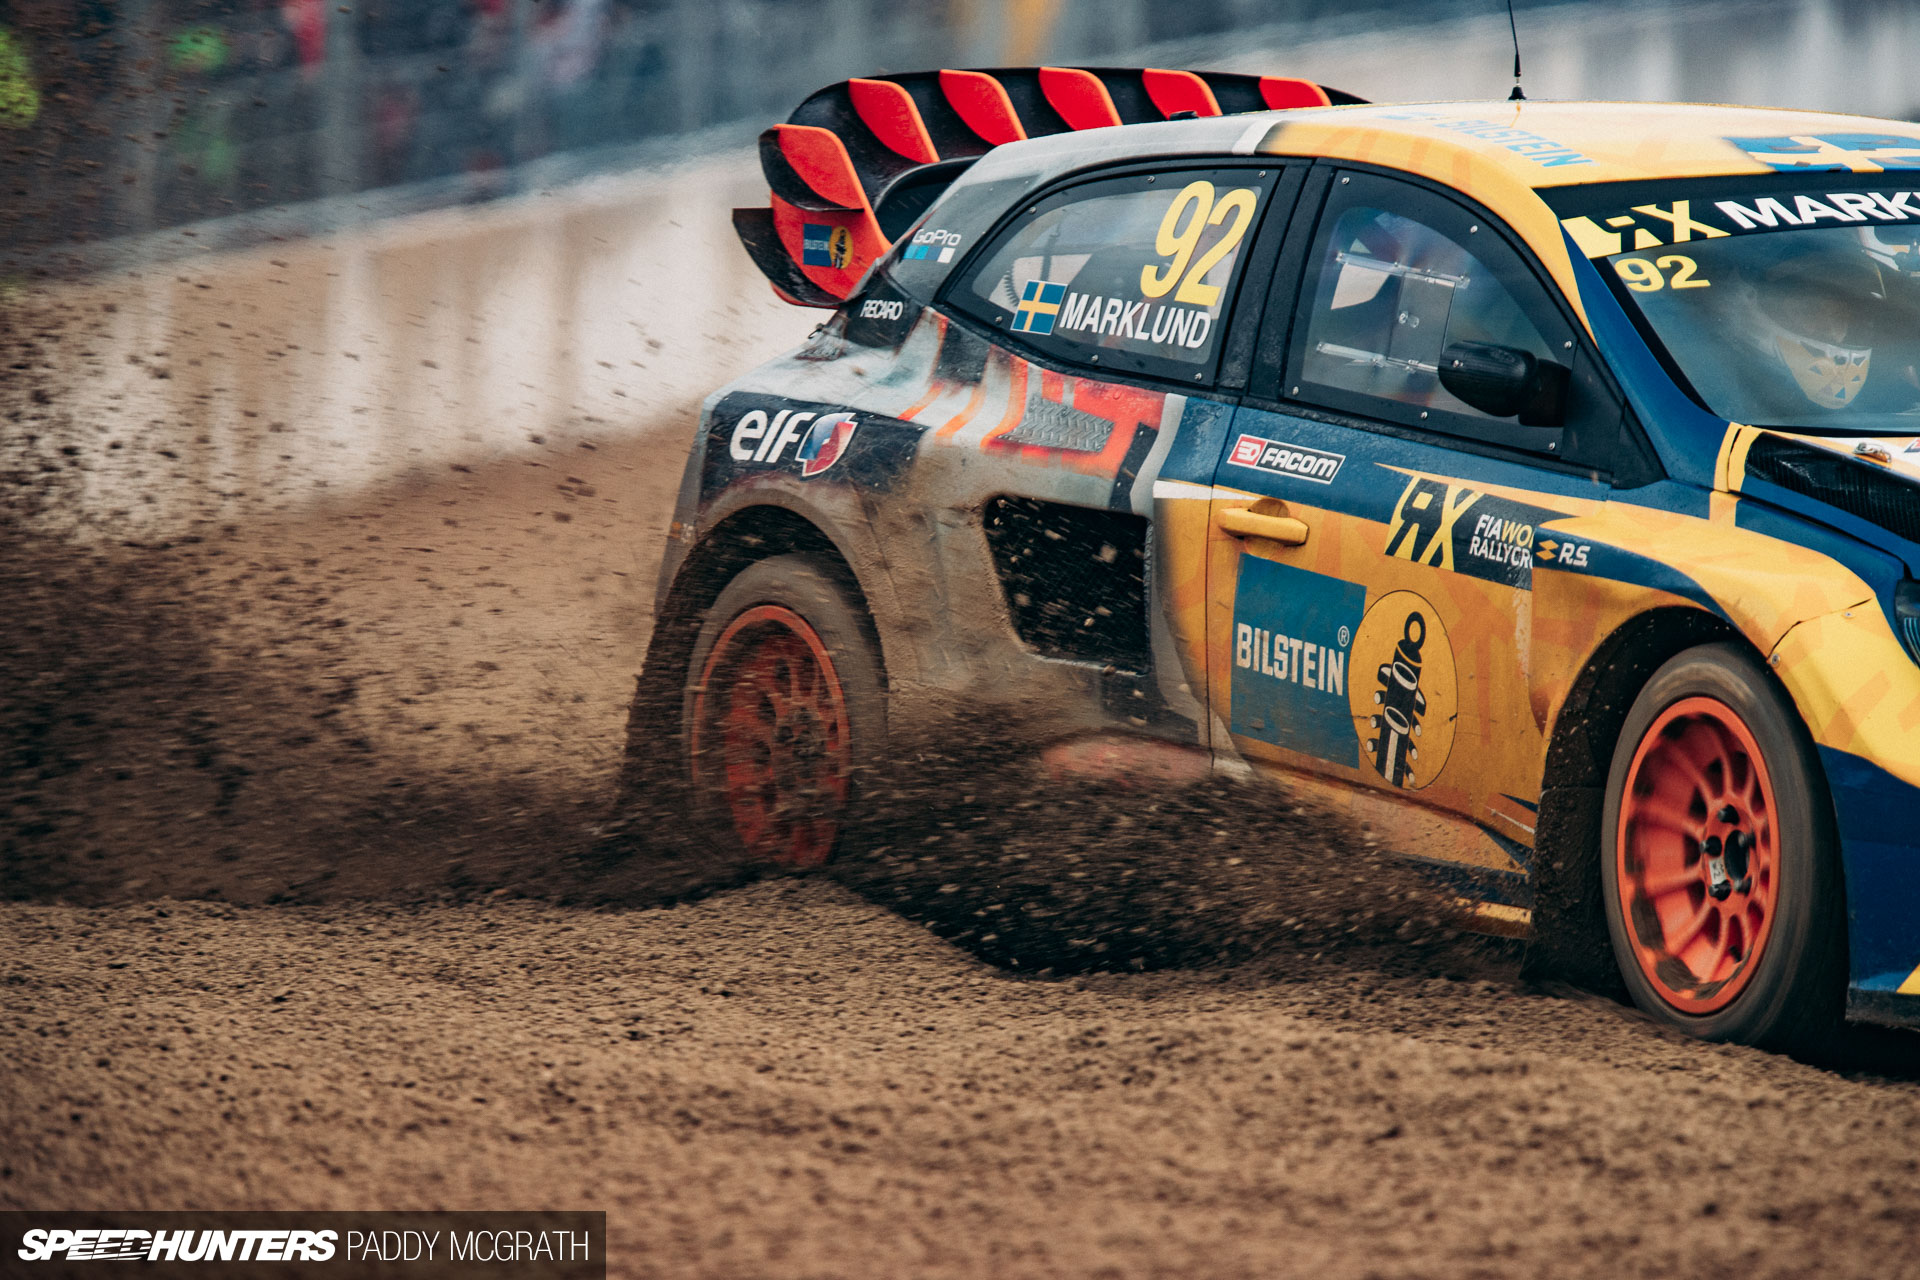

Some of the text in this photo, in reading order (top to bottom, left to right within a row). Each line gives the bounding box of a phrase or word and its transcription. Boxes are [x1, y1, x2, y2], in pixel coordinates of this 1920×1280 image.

[1714, 191, 1920, 230] MARK
[912, 228, 962, 246] GoPro
[1140, 180, 1258, 306] 92
[1613, 255, 1712, 293] 92
[859, 300, 904, 320] RECARO
[1060, 292, 1212, 349] MARKLUND
[730, 409, 817, 463] elf
[1260, 447, 1338, 478] FACOM
[1236, 622, 1344, 697] BILSTEIN
